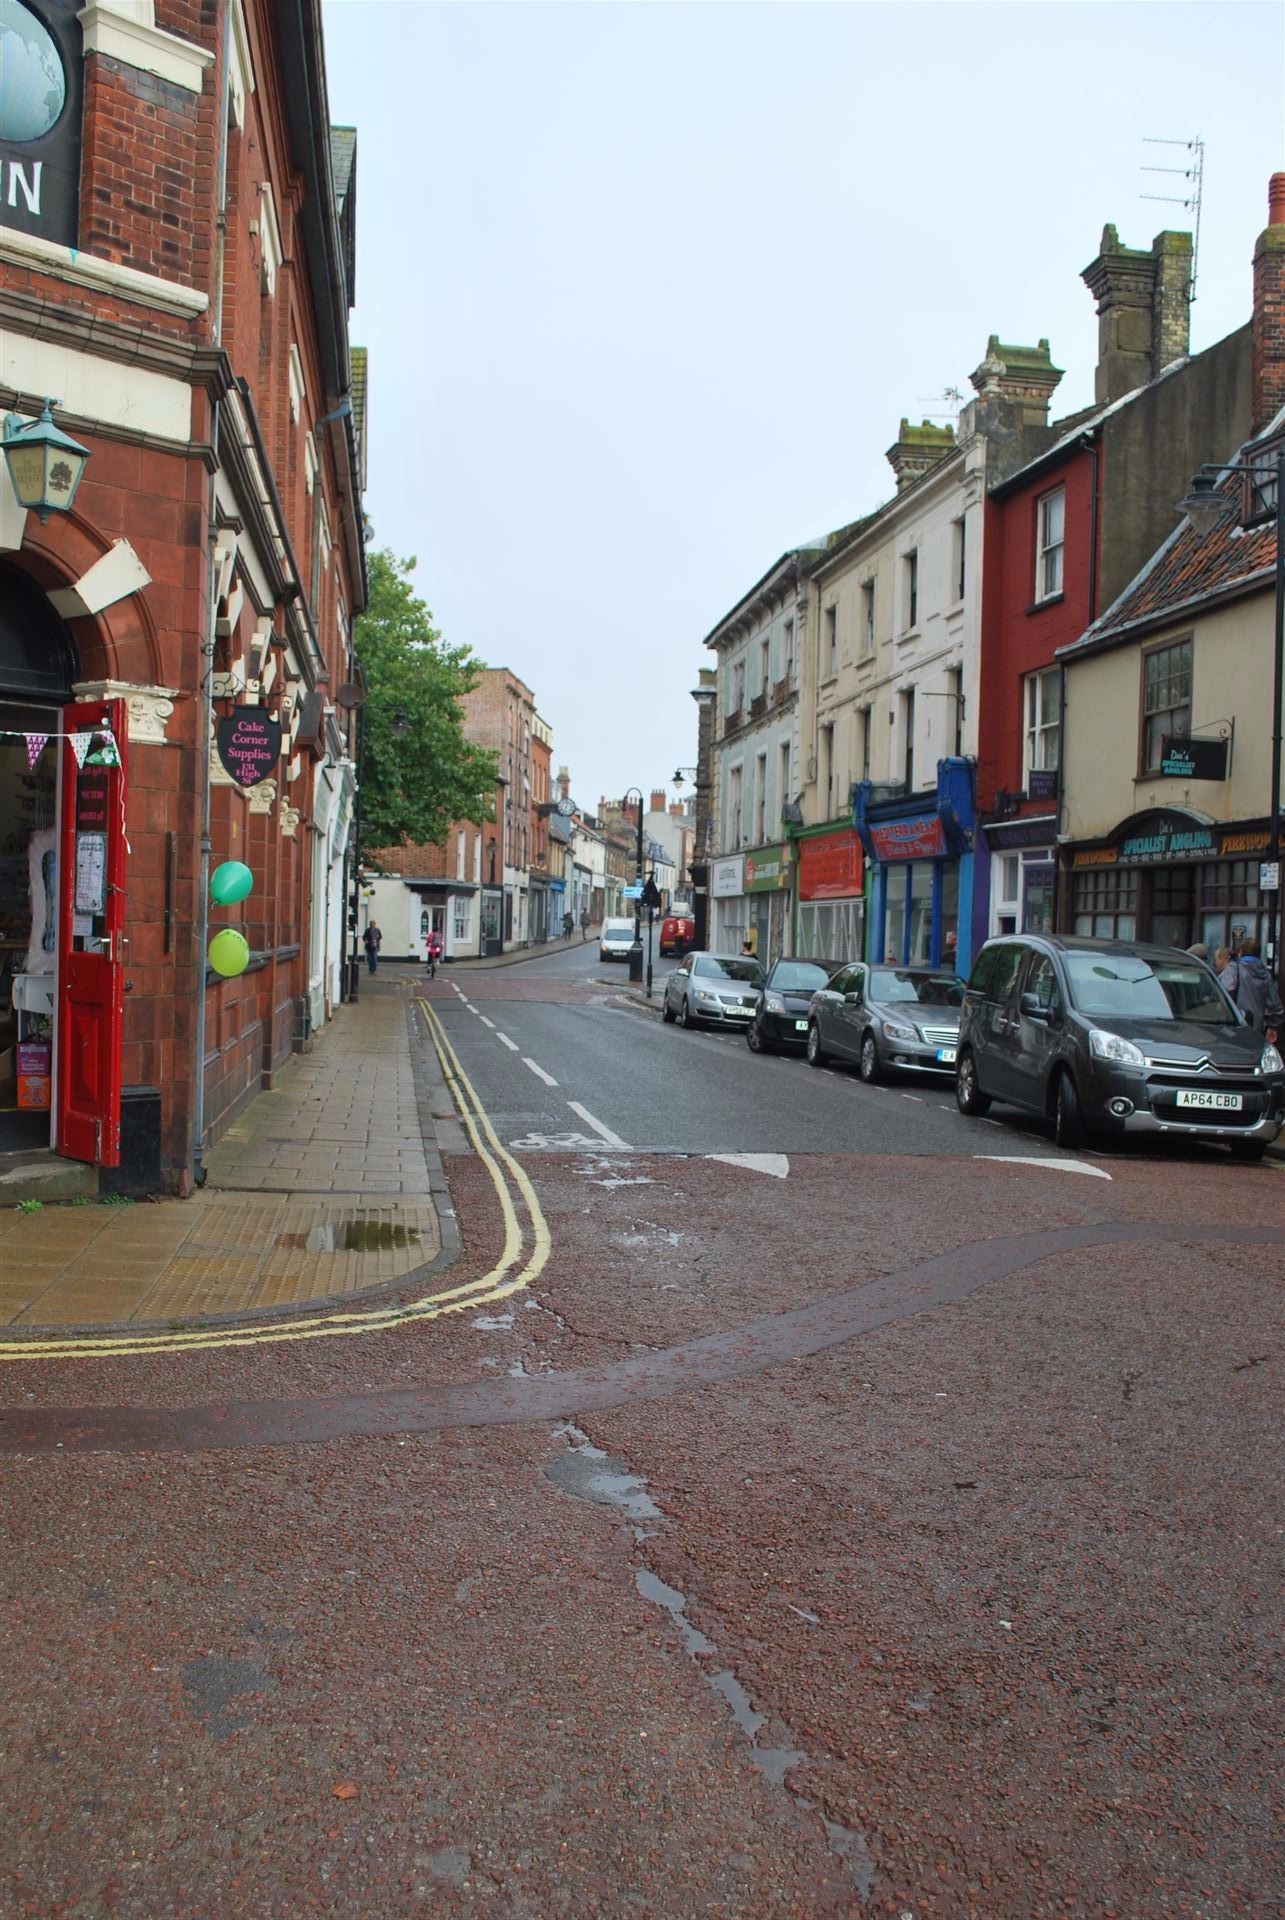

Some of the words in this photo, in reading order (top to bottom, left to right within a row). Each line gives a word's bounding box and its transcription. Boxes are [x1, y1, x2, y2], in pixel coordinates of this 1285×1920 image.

[0, 159, 43, 215] N
[237, 720, 265, 733] Cake
[231, 733, 270, 746] Corner
[227, 746, 272, 761] Supplies
[235, 768, 261, 779] High
[1163, 766, 1193, 776] ANGLING
[1123, 835, 1167, 855] SPECIALIST
[1169, 831, 1212, 850] ANGLING
[1183, 1093, 1213, 1105] AP64
